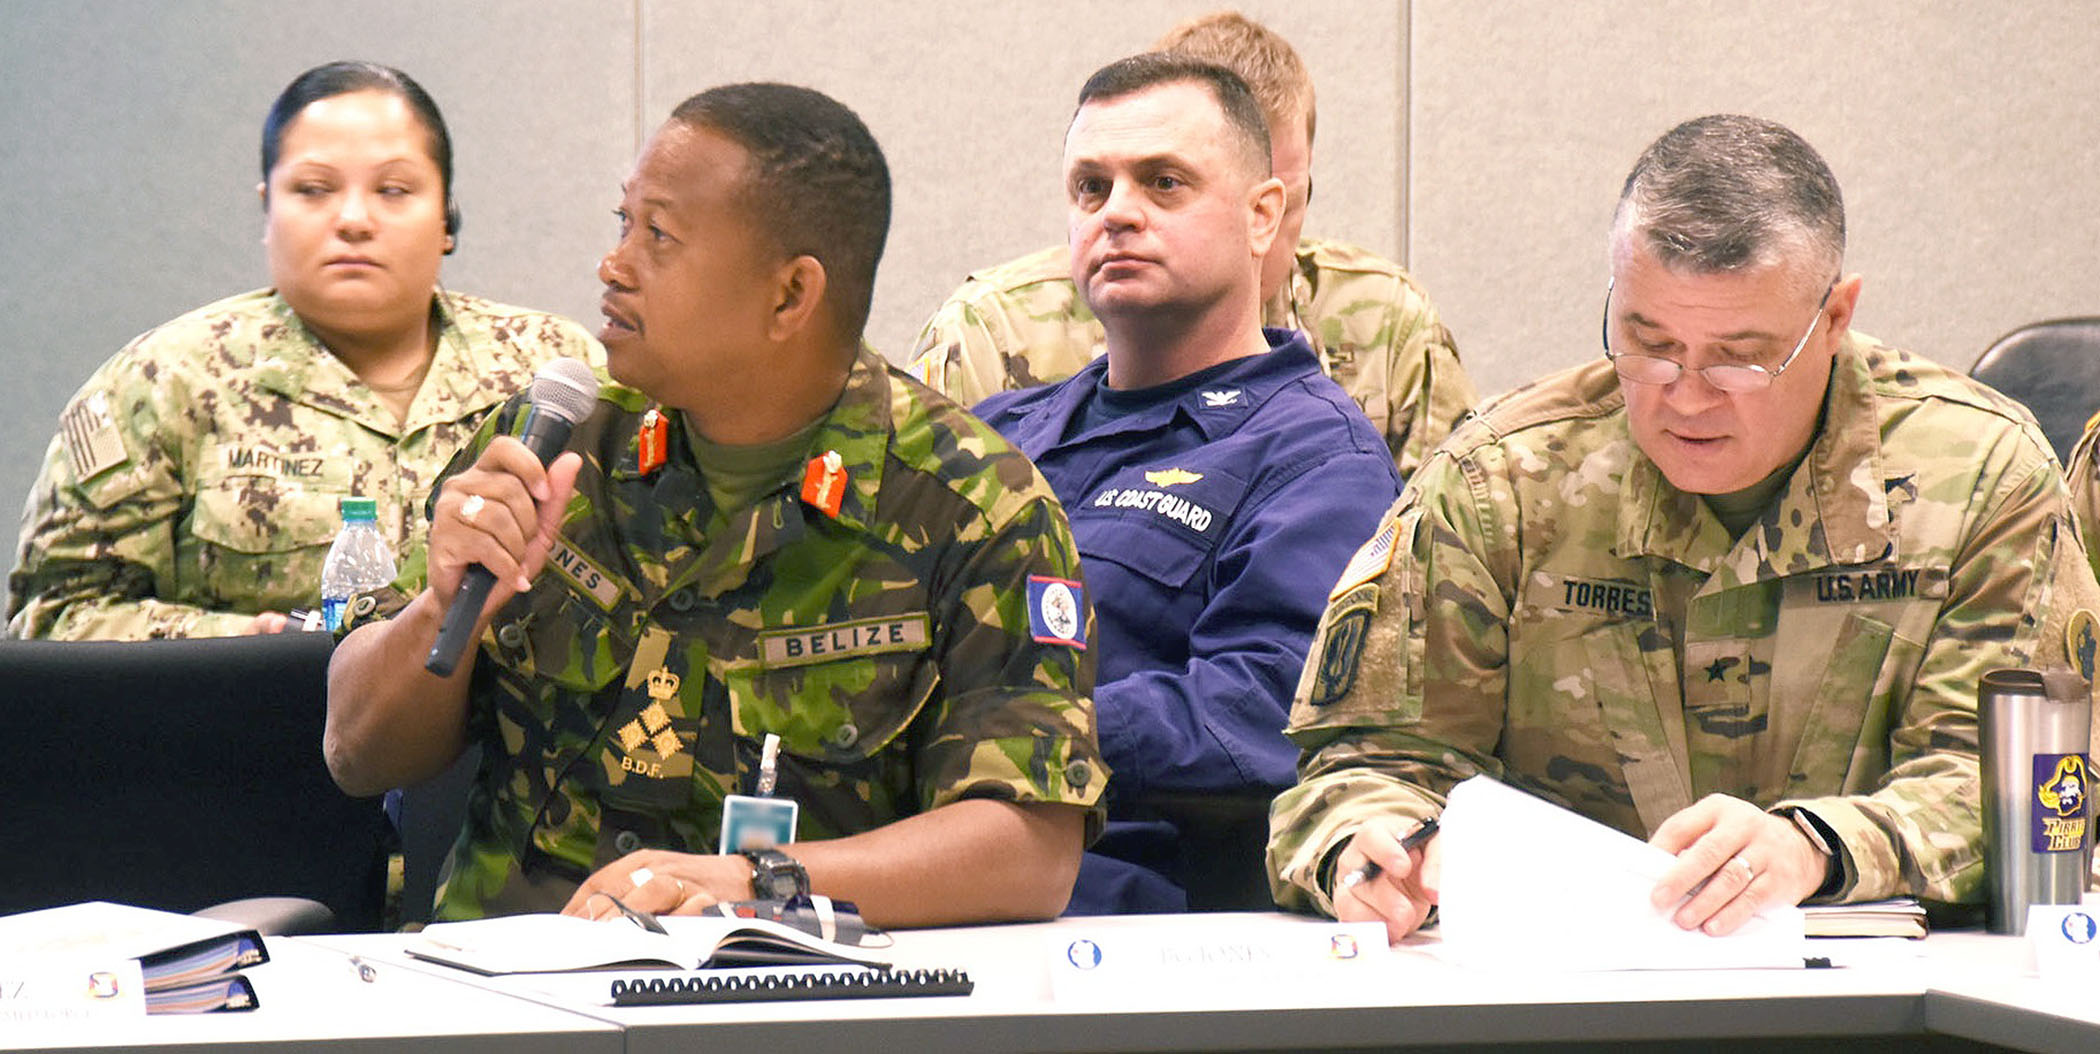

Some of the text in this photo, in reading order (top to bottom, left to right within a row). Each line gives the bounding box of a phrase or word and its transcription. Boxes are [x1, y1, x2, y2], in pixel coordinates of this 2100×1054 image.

[228, 448, 324, 476] MARTINEZ
[1114, 489, 1164, 511] COAST
[1157, 494, 1212, 532] GUARD
[551, 543, 601, 590] NES
[1563, 580, 1652, 616] TORRES
[1859, 568, 1920, 600] ARMY
[785, 623, 904, 657] BELIZE
[621, 755, 664, 779] B.D.F.
